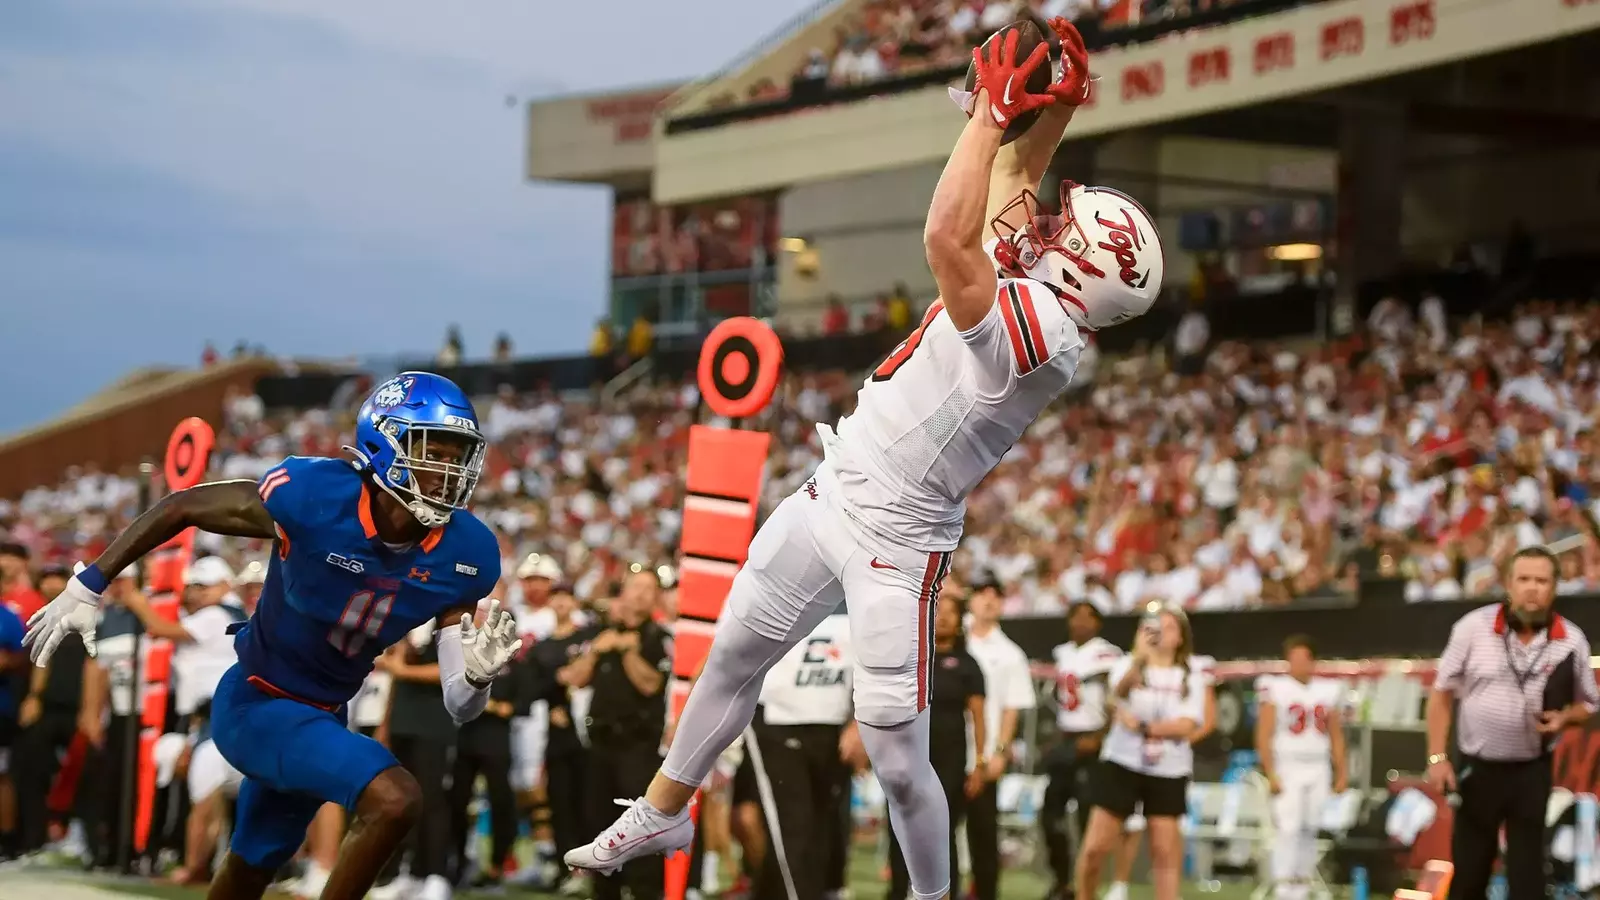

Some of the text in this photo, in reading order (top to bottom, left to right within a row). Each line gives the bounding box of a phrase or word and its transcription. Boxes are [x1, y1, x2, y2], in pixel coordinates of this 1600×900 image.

[1095, 207, 1148, 289] Tops
[455, 562, 479, 576] BROTHERS
[326, 589, 398, 659] 11
[795, 666, 847, 687] USA
